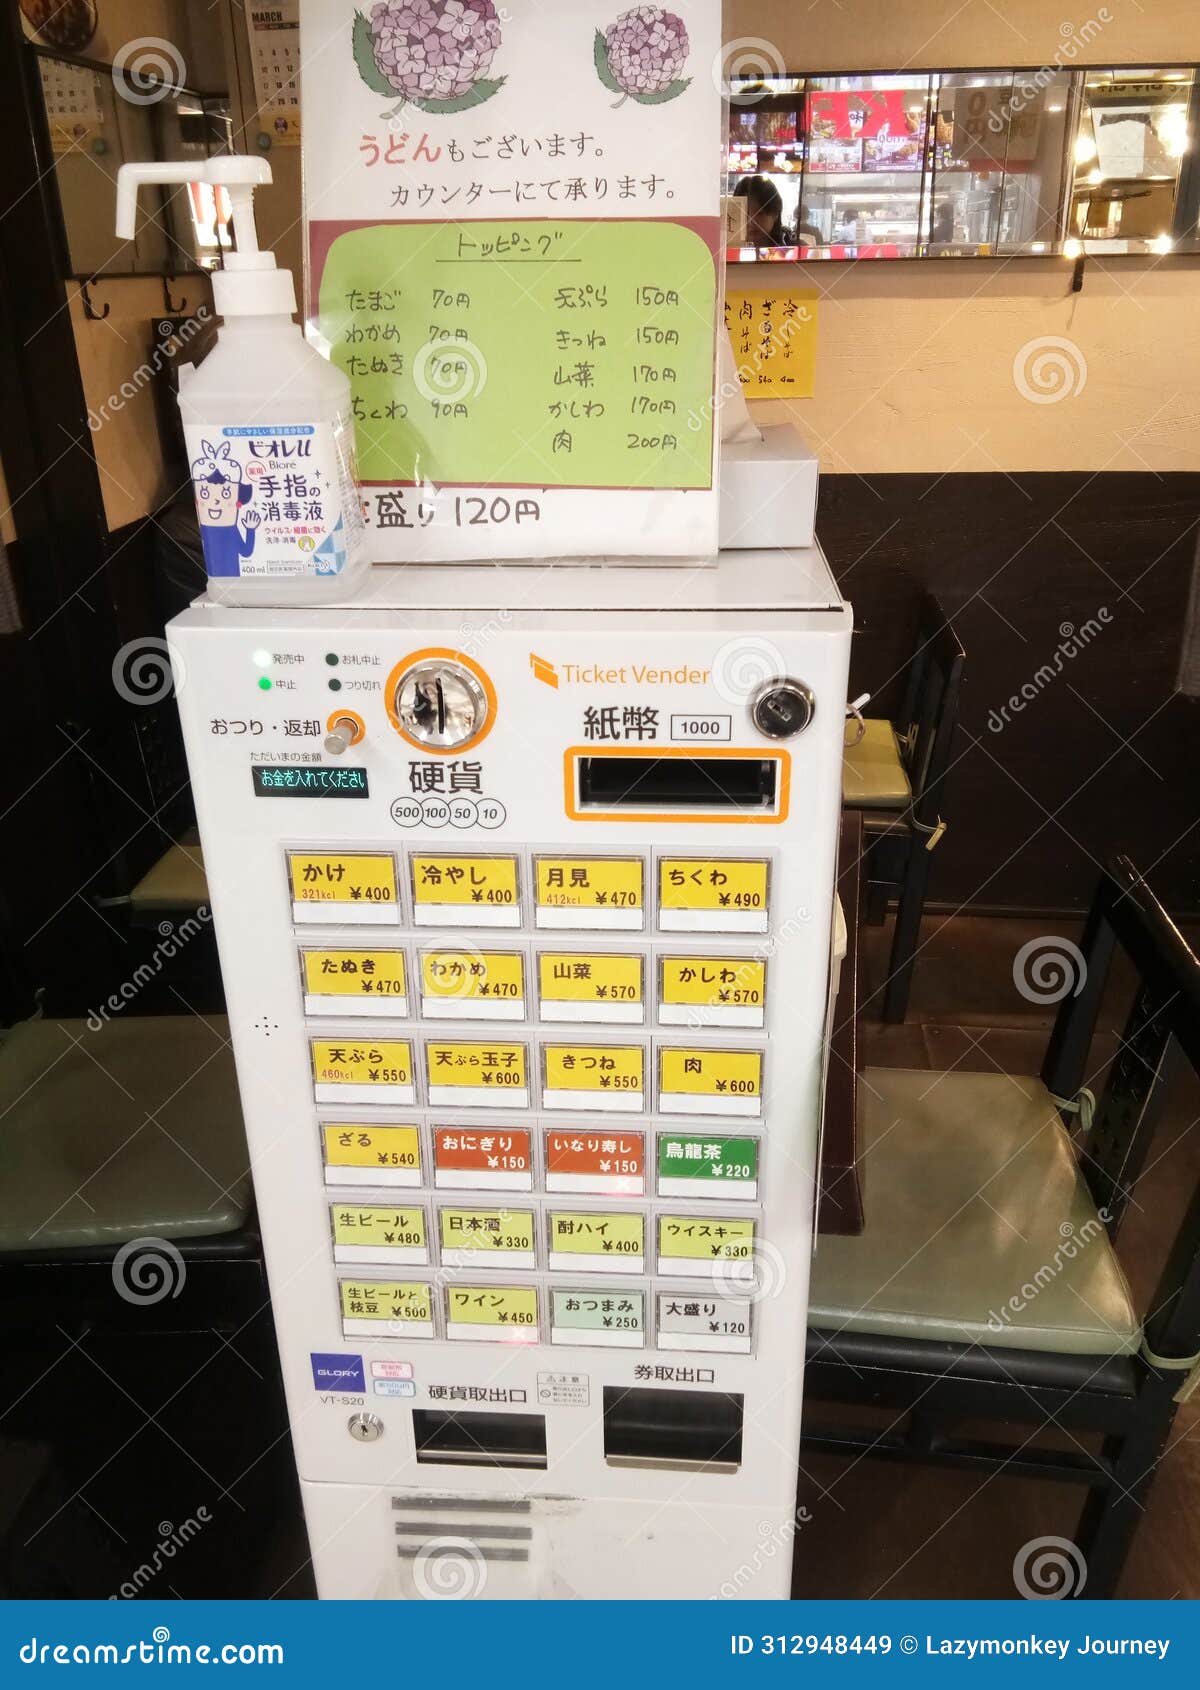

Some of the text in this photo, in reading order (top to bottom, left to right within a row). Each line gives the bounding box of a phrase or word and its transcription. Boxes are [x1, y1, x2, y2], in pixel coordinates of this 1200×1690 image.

[359, 131, 608, 167] うどんもございます。
[390, 173, 675, 208] カウンターにて承ります。
[457, 233, 563, 258] トッピング
[345, 289, 470, 311] たまご 70円
[554, 285, 679, 308] 天ぷら 150円
[345, 324, 468, 344] わかめ 70円
[556, 326, 679, 350] きつね 150円
[346, 353, 403, 376] たぬき
[554, 361, 676, 388] 山菜 170円
[351, 396, 468, 420] ちくわ 90円
[548, 396, 676, 418] かしわ 170円
[552, 429, 677, 453] 肉 200円
[259, 474, 321, 498] 手指の
[261, 501, 323, 522] 消毒液
[364, 490, 540, 528] 盛り 120円
[272, 653, 305, 665] 発売中
[342, 654, 381, 665] お札中止
[562, 664, 711, 685] Ticket Vender
[275, 680, 297, 690] 中止
[345, 680, 381, 691] つり切れ
[210, 718, 321, 737] おつり・返却
[583, 706, 660, 741] 紙幣
[680, 721, 720, 735] 1000
[250, 751, 322, 762] ただいまの金額
[408, 760, 484, 795] 硬貨
[394, 806, 498, 819] 500 100 50 10
[302, 863, 345, 882] かけ
[421, 865, 487, 885] 冷やし
[546, 868, 590, 888] 月見
[668, 869, 727, 886] ちくわ
[350, 886, 391, 901] ¥400
[472, 889, 512, 903] ¥400
[595, 891, 636, 906] ¥470
[719, 892, 760, 907] ¥490
[321, 958, 376, 974] たぬき
[430, 960, 486, 977] わかめ
[553, 963, 592, 979] 山菜
[679, 967, 737, 984] かしわ
[361, 980, 401, 993] ¥470
[479, 983, 518, 996] ¥470
[596, 985, 636, 999] ¥570
[719, 989, 759, 1003] ¥570
[562, 1054, 616, 1070] きつね
[684, 1058, 702, 1074] 肉
[368, 1069, 407, 1082] ¥550
[482, 1071, 520, 1085] ¥600
[600, 1075, 638, 1088] ¥550
[716, 1079, 755, 1093] ¥600
[338, 1132, 372, 1147] ざる
[443, 1135, 513, 1151] おにぎり
[554, 1139, 632, 1154] いなり寿し
[378, 1152, 415, 1165] ¥540
[487, 1156, 525, 1169] ¥150
[600, 1159, 638, 1173] ¥150
[711, 1163, 750, 1177] ¥220
[339, 1213, 409, 1227] 生ビール
[449, 1216, 501, 1231] 日本酒
[557, 1220, 609, 1235] 酎ハイ
[384, 1232, 420, 1244] ¥480
[667, 1224, 743, 1238] ウイスキー
[492, 1236, 529, 1248] ¥330
[602, 1240, 639, 1252] ¥400
[348, 1288, 418, 1300] 生ビールと
[455, 1293, 505, 1308] ワイン
[350, 1301, 379, 1314] 枝豆
[566, 1298, 634, 1312] おつまみ
[665, 1302, 717, 1316] 大盛り
[498, 1311, 533, 1324] ¥450
[602, 1316, 638, 1329] ¥250
[709, 1321, 745, 1334] ¥120
[317, 1369, 360, 1377] GLORY
[634, 1364, 715, 1383] 券取出口
[320, 1396, 365, 1406] VT-S20
[428, 1385, 527, 1403] 硬貨取出口
